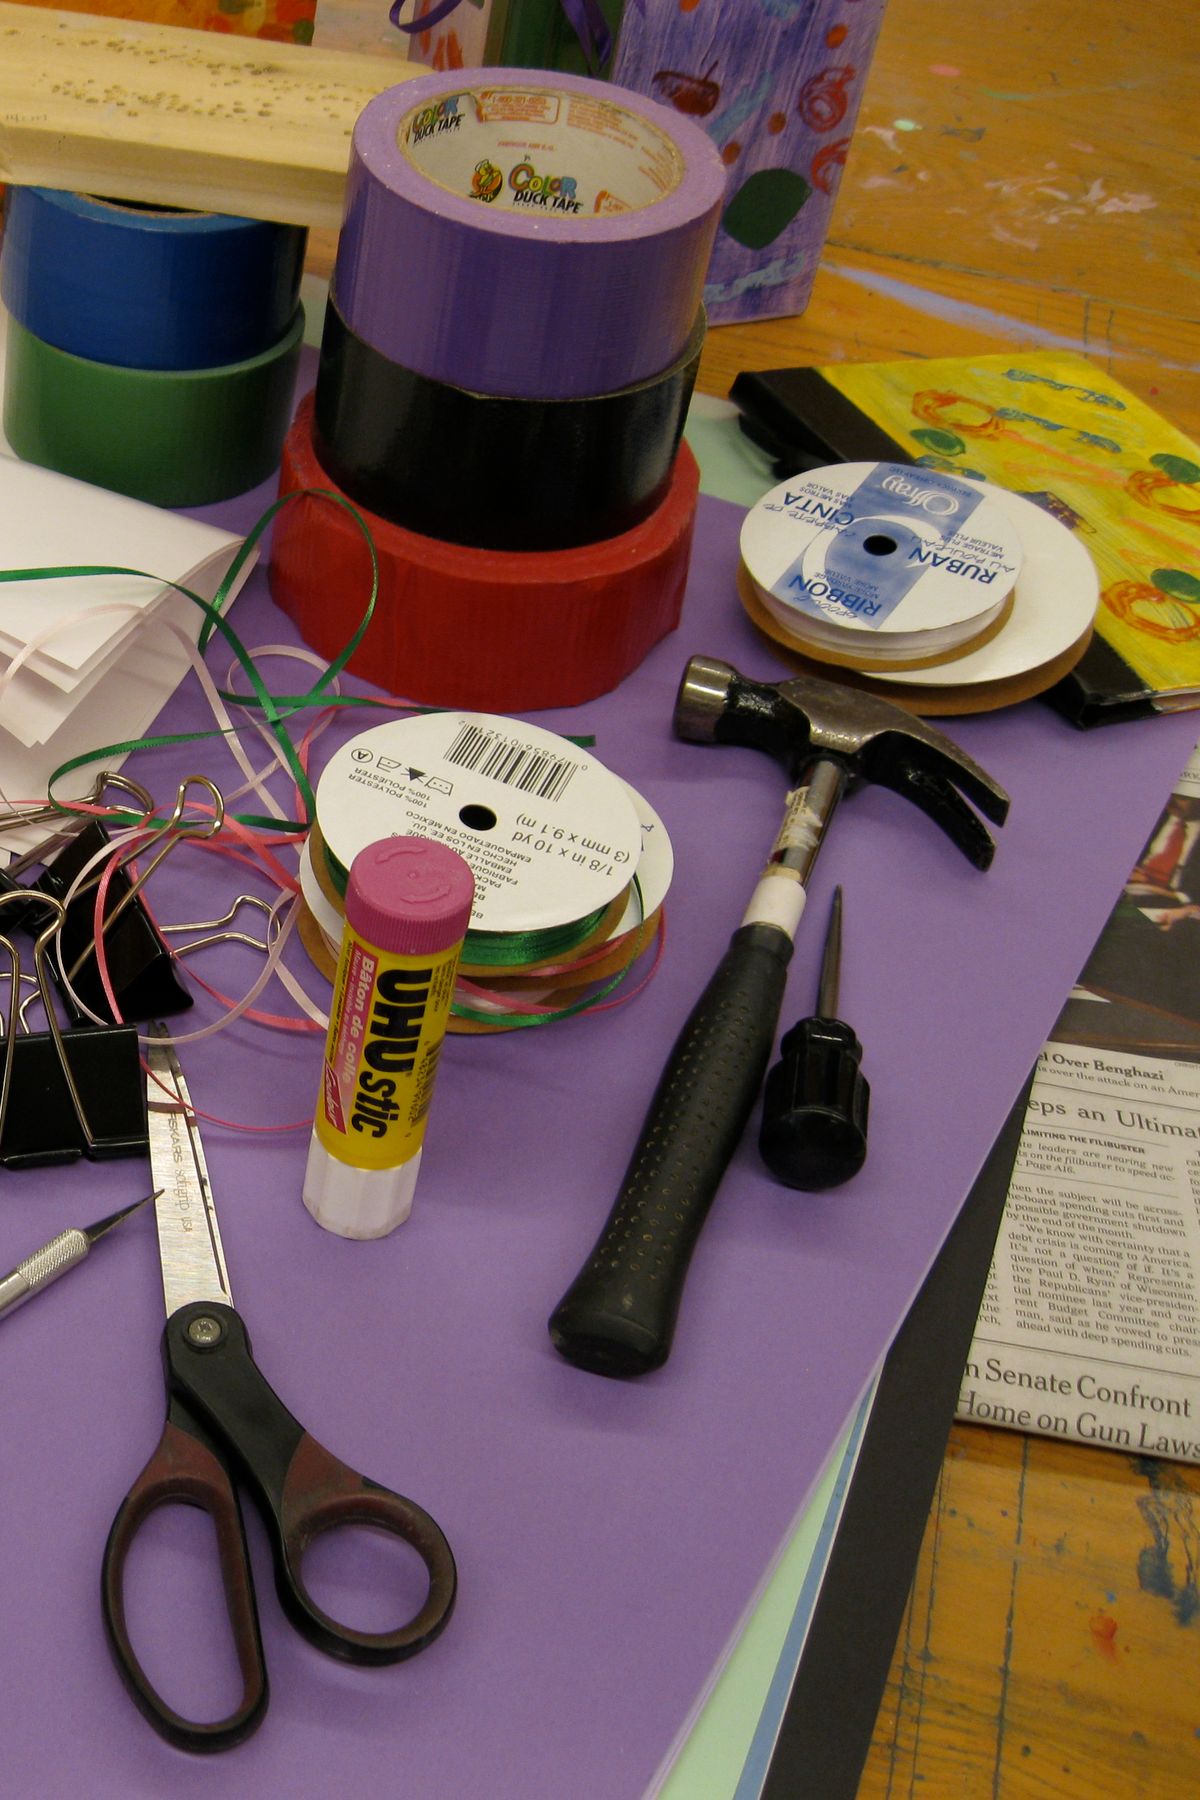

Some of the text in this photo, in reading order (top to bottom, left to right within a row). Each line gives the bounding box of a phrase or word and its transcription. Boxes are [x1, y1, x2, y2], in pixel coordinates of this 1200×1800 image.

[438, 115, 462, 132] TAPE
[513, 190, 549, 206] DUCK
[552, 195, 583, 214] TAPE
[783, 491, 853, 525] CINTA
[881, 474, 958, 515] Offray
[970, 537, 1003, 552] VALEUR
[908, 547, 997, 584] RUBAN
[788, 574, 882, 616] RIBBON
[347, 773, 427, 808] 100% POLYESTER
[443, 825, 457, 834] EN
[445, 835, 465, 847] LOS
[515, 812, 630, 863] (3 mm x 9.1 m)
[458, 831, 531, 862] EMPAQUETADO
[467, 843, 481, 852] EN
[482, 849, 517, 866] HECHO
[511, 831, 613, 875] 1/8 in x 10 yd
[342, 955, 375, 1083] Bâton de colle
[364, 968, 433, 1073] UHU
[1052, 1052, 1090, 1068] Over
[1092, 1058, 1164, 1080] Benghazi
[1076, 1069, 1094, 1080] the
[1096, 1074, 1130, 1086] attack
[1132, 1081, 1148, 1089] on
[1150, 1084, 1164, 1092] an
[1167, 1085, 1200, 1098] Amer
[351, 1070, 400, 1139] stic
[1076, 1108, 1104, 1122] an
[1114, 1109, 1200, 1140] Ultima
[1038, 1142, 1173, 1172] leaders are nearing new
[1068, 1135, 1086, 1144] THE
[1088, 1138, 1145, 1154] FILIBUSTER
[1025, 1158, 1052, 1171] Page
[1045, 1152, 1062, 1162] the
[1064, 1155, 1112, 1170] filibuster
[1114, 1163, 1125, 1173] to
[1126, 1168, 1157, 1178] speed
[1035, 1185, 1052, 1195] the
[1058, 1190, 1096, 1202] subject
[1100, 1196, 1121, 1206] will
[1125, 1200, 1138, 1209] be
[1005, 1209, 1018, 1222] by
[1022, 1212, 1039, 1223] the
[1041, 1217, 1060, 1226] end
[1064, 1220, 1076, 1229] of
[1077, 1221, 1095, 1232] the
[1014, 1203, 1186, 1237] possible government shutdown
[1060, 1201, 1108, 1217] spending
[1111, 1209, 1134, 1219] cuts
[1137, 1211, 1160, 1223] first
[1163, 1218, 1184, 1227] and
[1008, 1230, 1032, 1242] debt
[1036, 1236, 1066, 1248] crisis
[1082, 1245, 1122, 1259] coming
[1126, 1250, 1137, 1259] to
[1045, 1226, 1180, 1256] know with certainty that
[1010, 1254, 1058, 1267] question
[1064, 1261, 1076, 1270] of
[1034, 1247, 1052, 1256] not
[1072, 1254, 1119, 1267] question
[1126, 1261, 1138, 1270] of
[1011, 1262, 1032, 1273] tive
[1038, 1267, 1063, 1278] Paul
[1086, 1275, 1115, 1287] Ryan
[1120, 1281, 1132, 1290] of
[1012, 1274, 1030, 1284] the
[1013, 1284, 1032, 1295] tial
[1037, 1291, 1086, 1304] nominee
[1091, 1297, 1112, 1309] last
[1119, 1305, 1143, 1314] year
[1150, 1310, 1171, 1319] and
[1014, 1299, 1038, 1308] rent
[1048, 1302, 1088, 1316] Budget
[1097, 1310, 1160, 1328] Committee
[1016, 1320, 1051, 1333] ahead
[1053, 1326, 1078, 1337] with
[1080, 1330, 1108, 1345] deep
[1110, 1338, 1162, 1354] spending
[1048, 1315, 1072, 1325] said
[1077, 1320, 1090, 1328] as
[1095, 1321, 1109, 1331] he
[1113, 1327, 1151, 1338] vowed
[1156, 1331, 1167, 1341] to
[984, 1358, 1191, 1417] Senate Confront
[958, 1389, 1200, 1458] Home on Gun Laws
